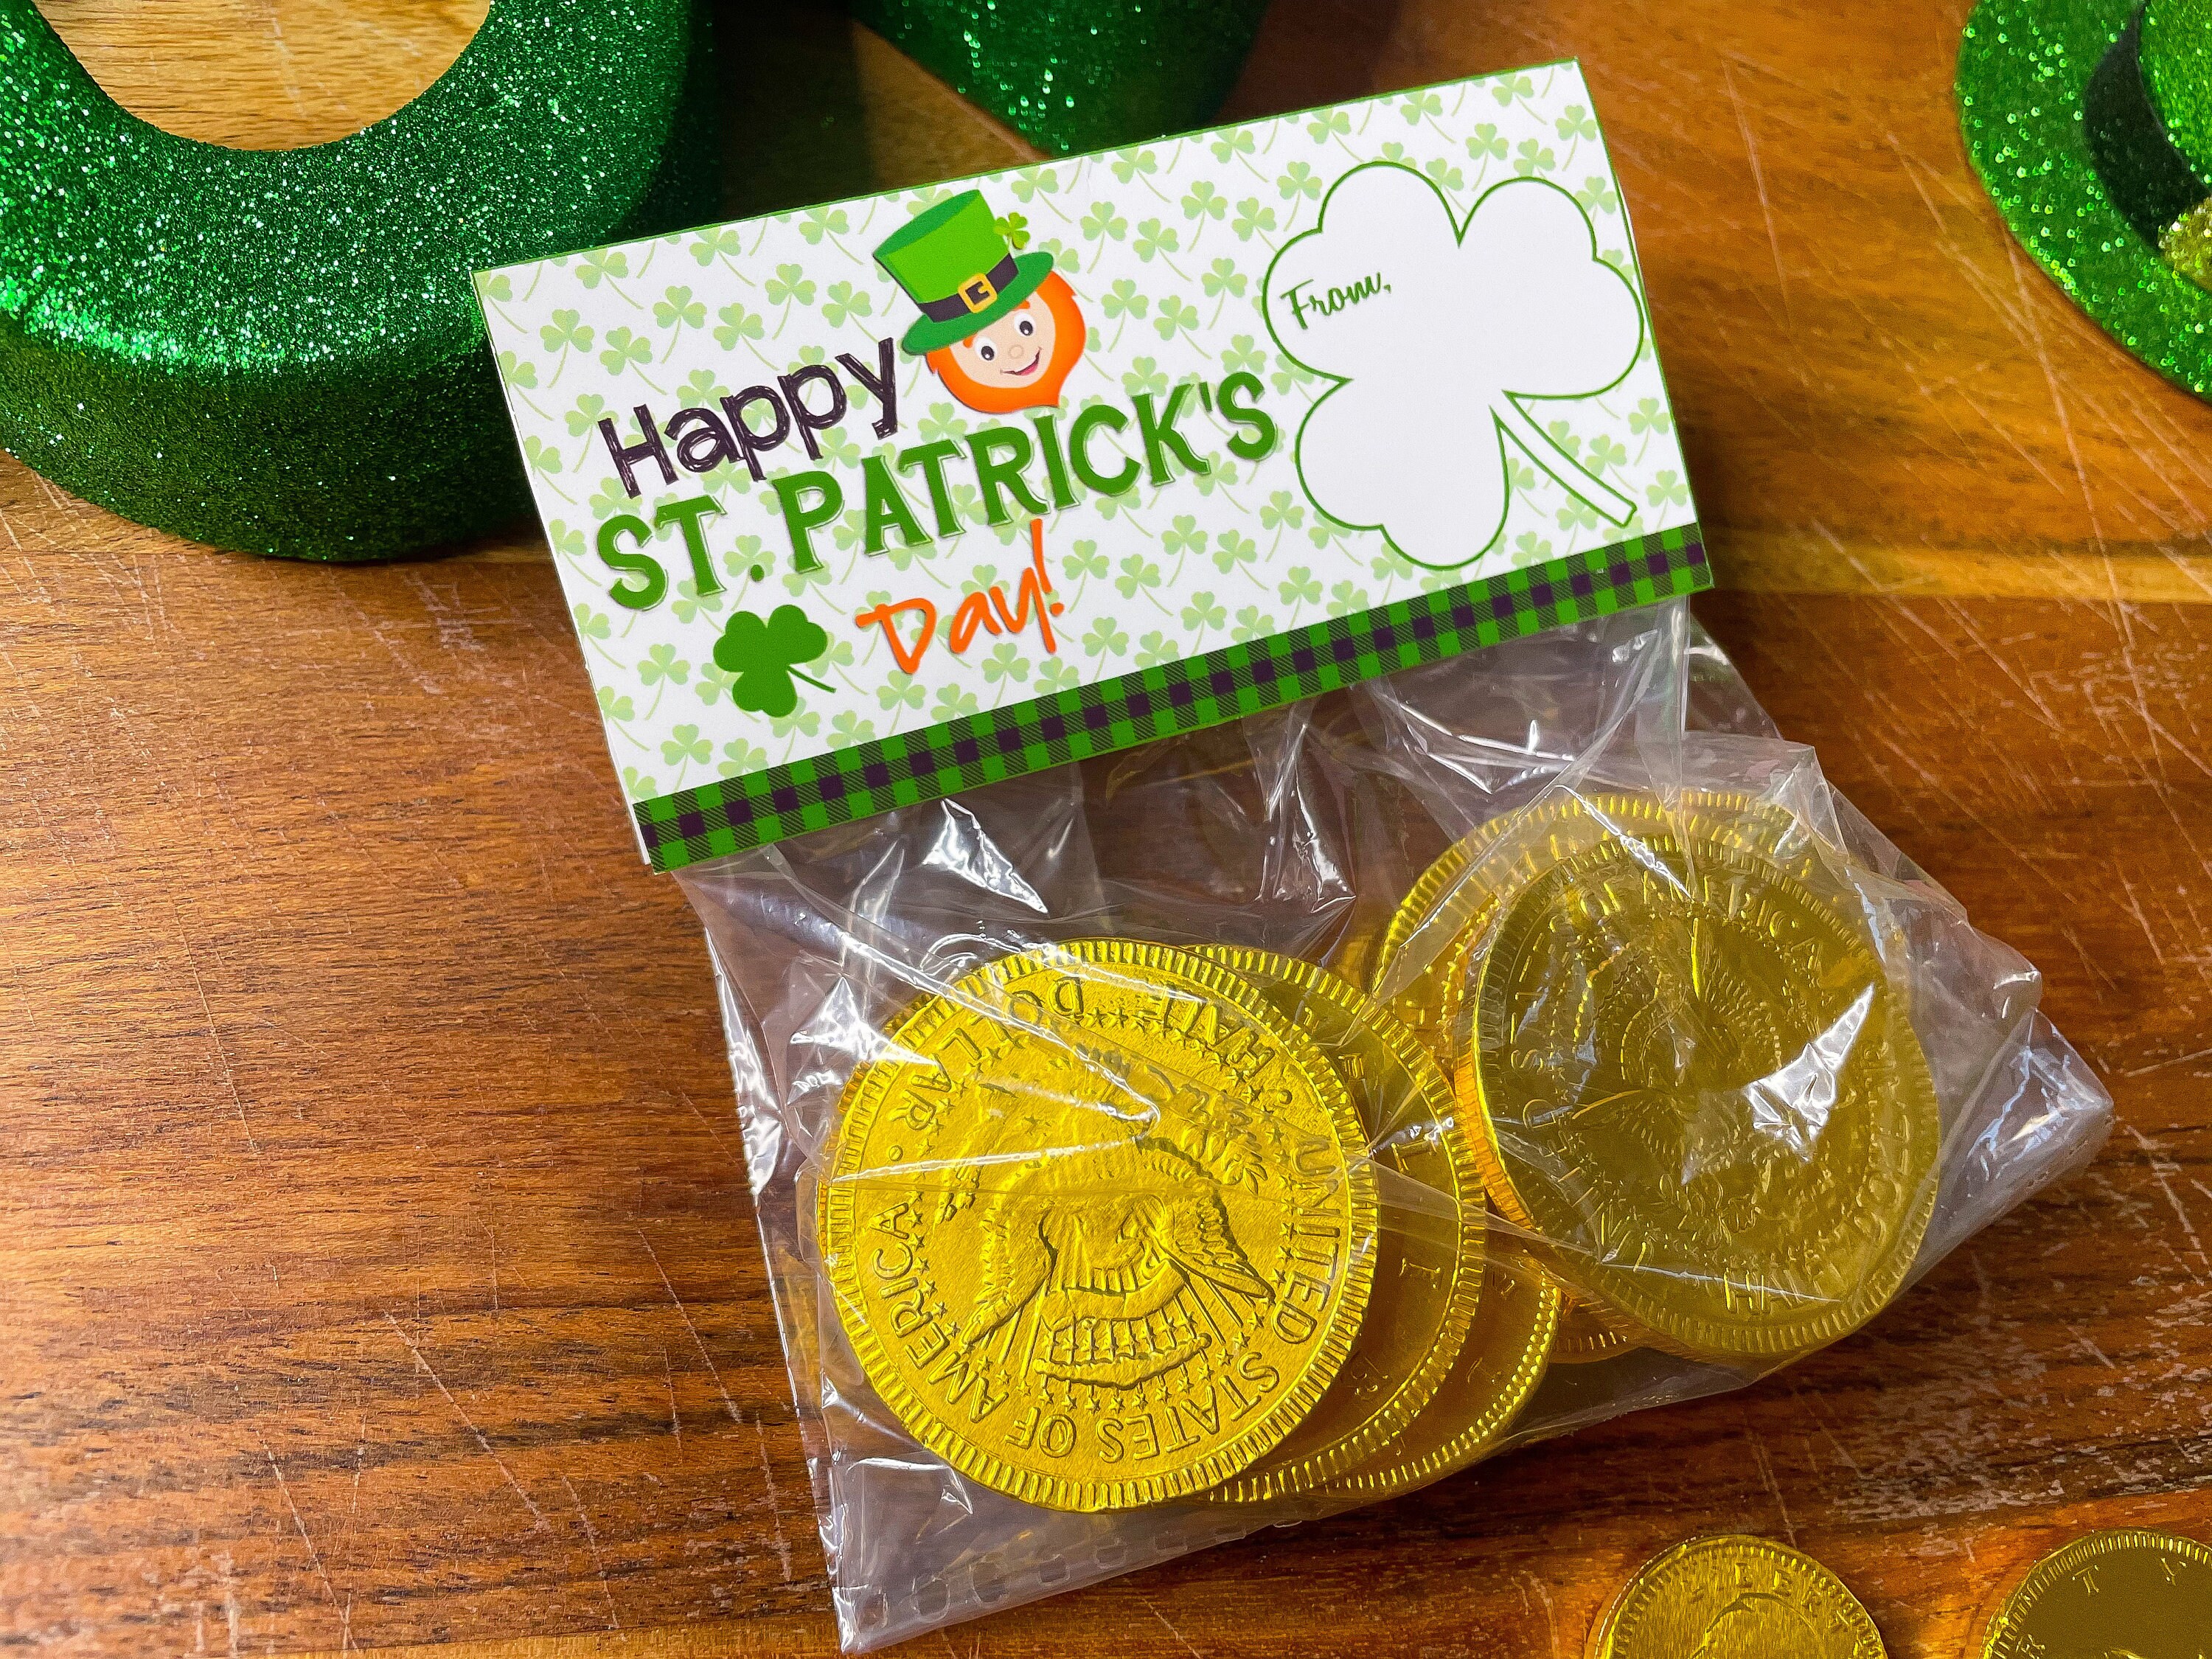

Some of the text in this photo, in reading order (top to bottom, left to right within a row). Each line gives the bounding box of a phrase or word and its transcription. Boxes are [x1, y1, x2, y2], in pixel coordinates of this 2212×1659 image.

[597, 372, 1279, 611] ST. PATRICK'S
[598, 337, 898, 498] Happy
[855, 518, 1065, 675] Day!
[871, 1201, 1008, 1422] AMERICA
[1270, 1139, 1340, 1344] UNITED
[1005, 1407, 1078, 1458] OF
[1096, 1352, 1280, 1462] STATES
